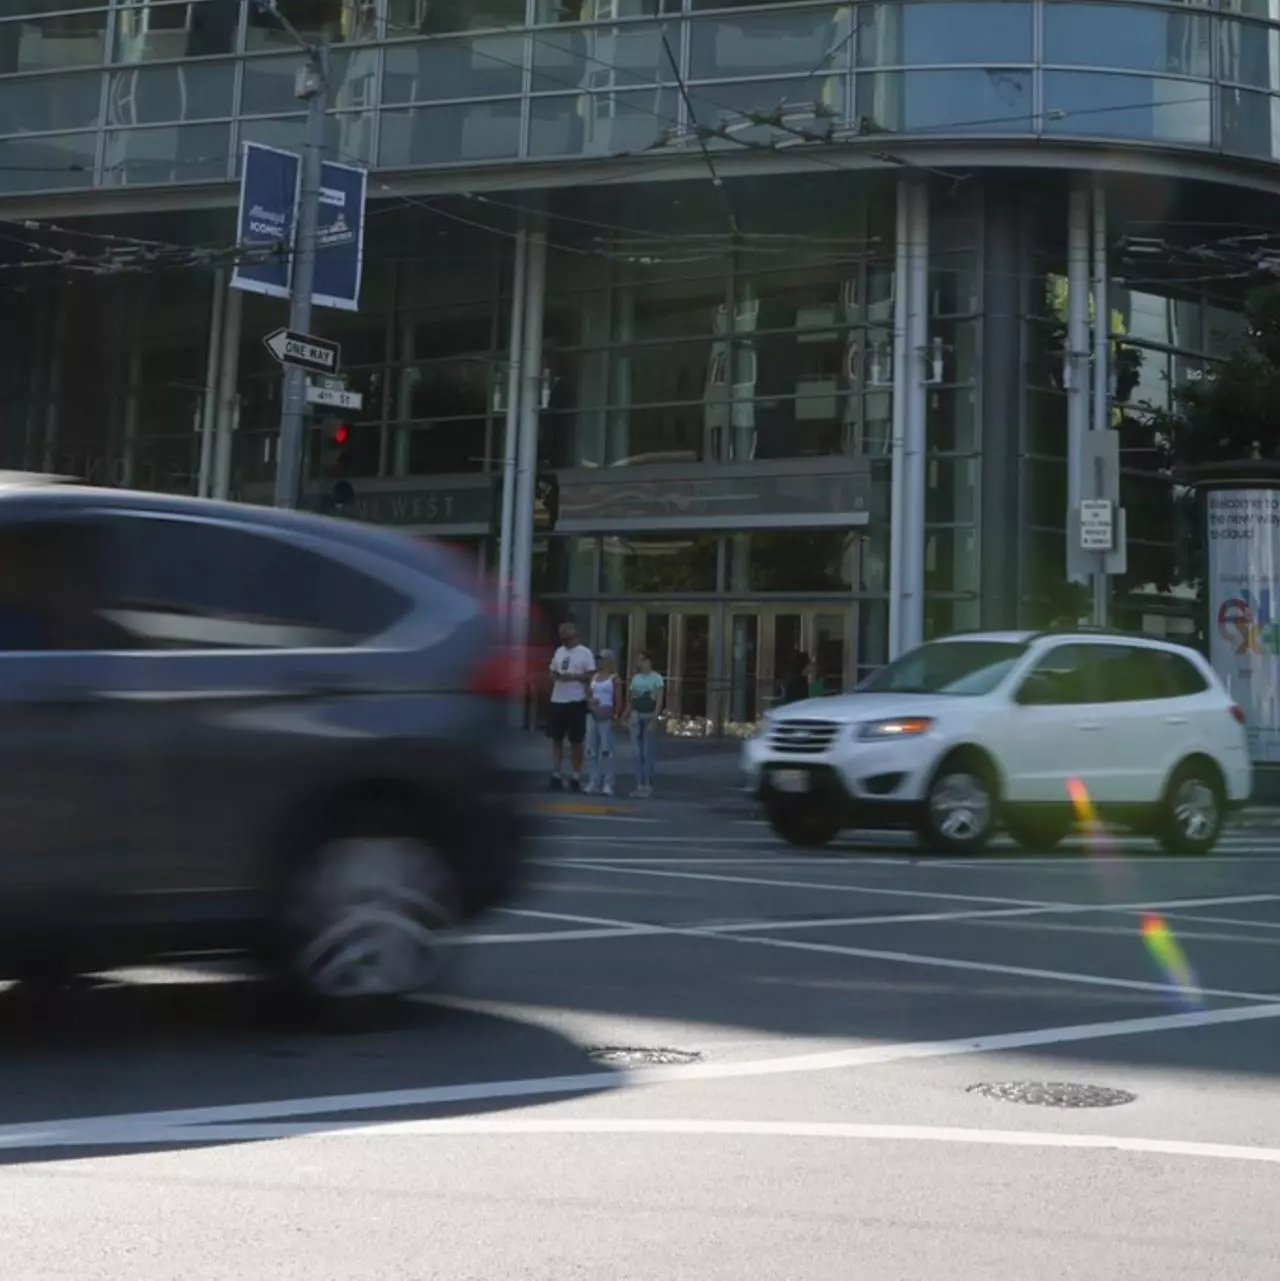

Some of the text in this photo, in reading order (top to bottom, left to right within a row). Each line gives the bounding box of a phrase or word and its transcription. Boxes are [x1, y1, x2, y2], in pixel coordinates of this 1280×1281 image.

[286, 341, 330, 363] ONE WAY
[392, 495, 456, 519] WEST
[1221, 527, 1254, 539] cloud
